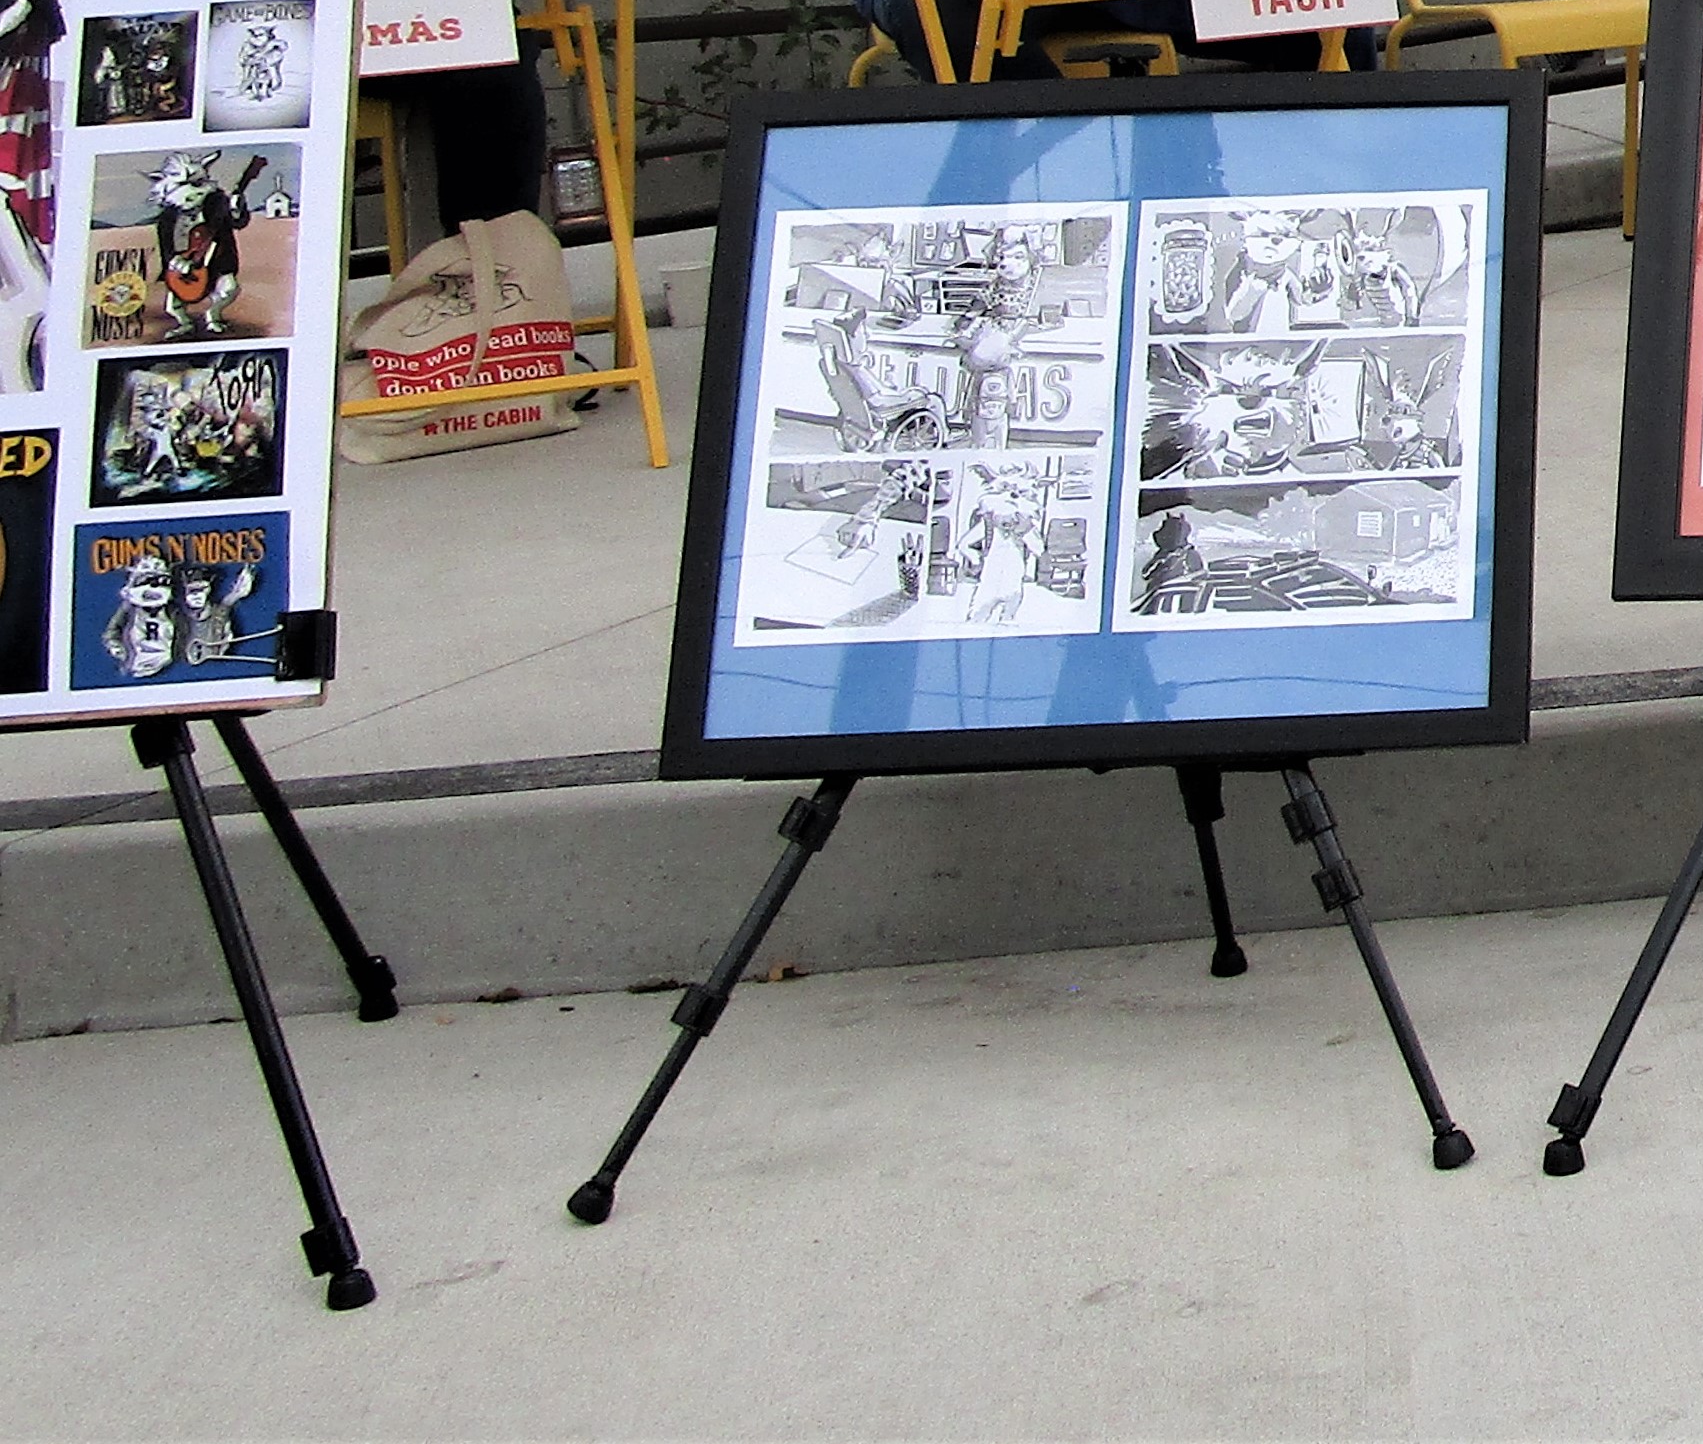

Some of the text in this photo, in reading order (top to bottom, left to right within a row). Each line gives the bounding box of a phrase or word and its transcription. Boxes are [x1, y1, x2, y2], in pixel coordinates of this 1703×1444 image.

[366, 14, 463, 46] MÁS
[372, 327, 571, 373] ople who ead books
[499, 360, 559, 380] books
[441, 406, 541, 433] THE CABIN
[91, 533, 163, 574] GUMS
[193, 528, 266, 565] NOSES
